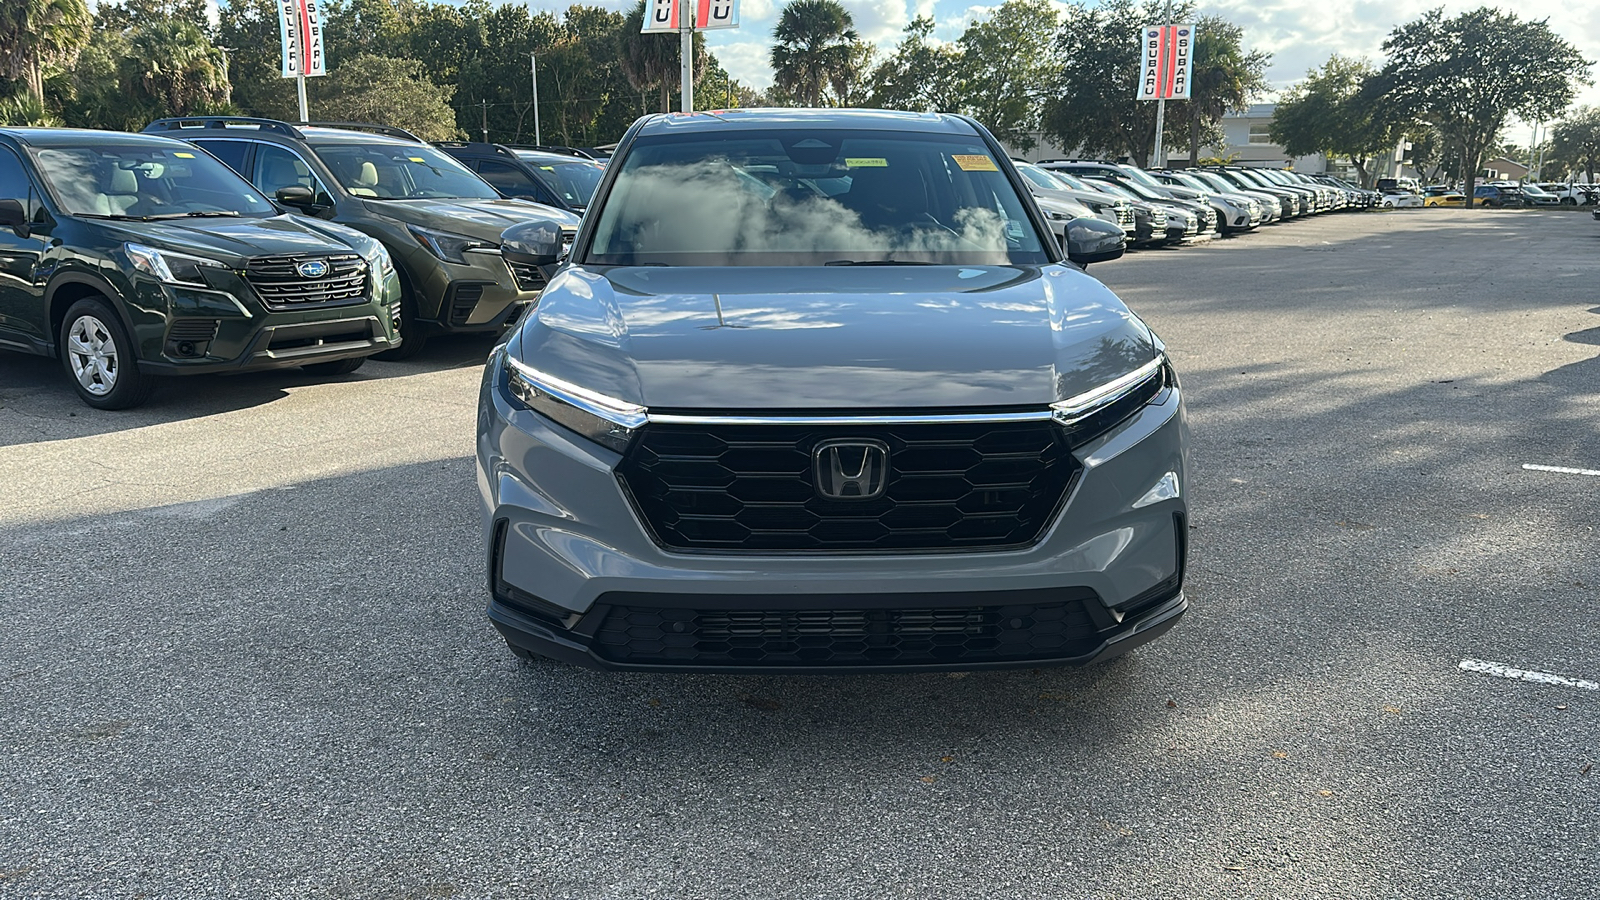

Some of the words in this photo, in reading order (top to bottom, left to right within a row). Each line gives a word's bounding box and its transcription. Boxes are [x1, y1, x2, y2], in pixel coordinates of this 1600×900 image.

[307, 3, 320, 69] SUBARU
[1145, 40, 1158, 95] SUBARU
[1174, 39, 1188, 94] SUBARU
